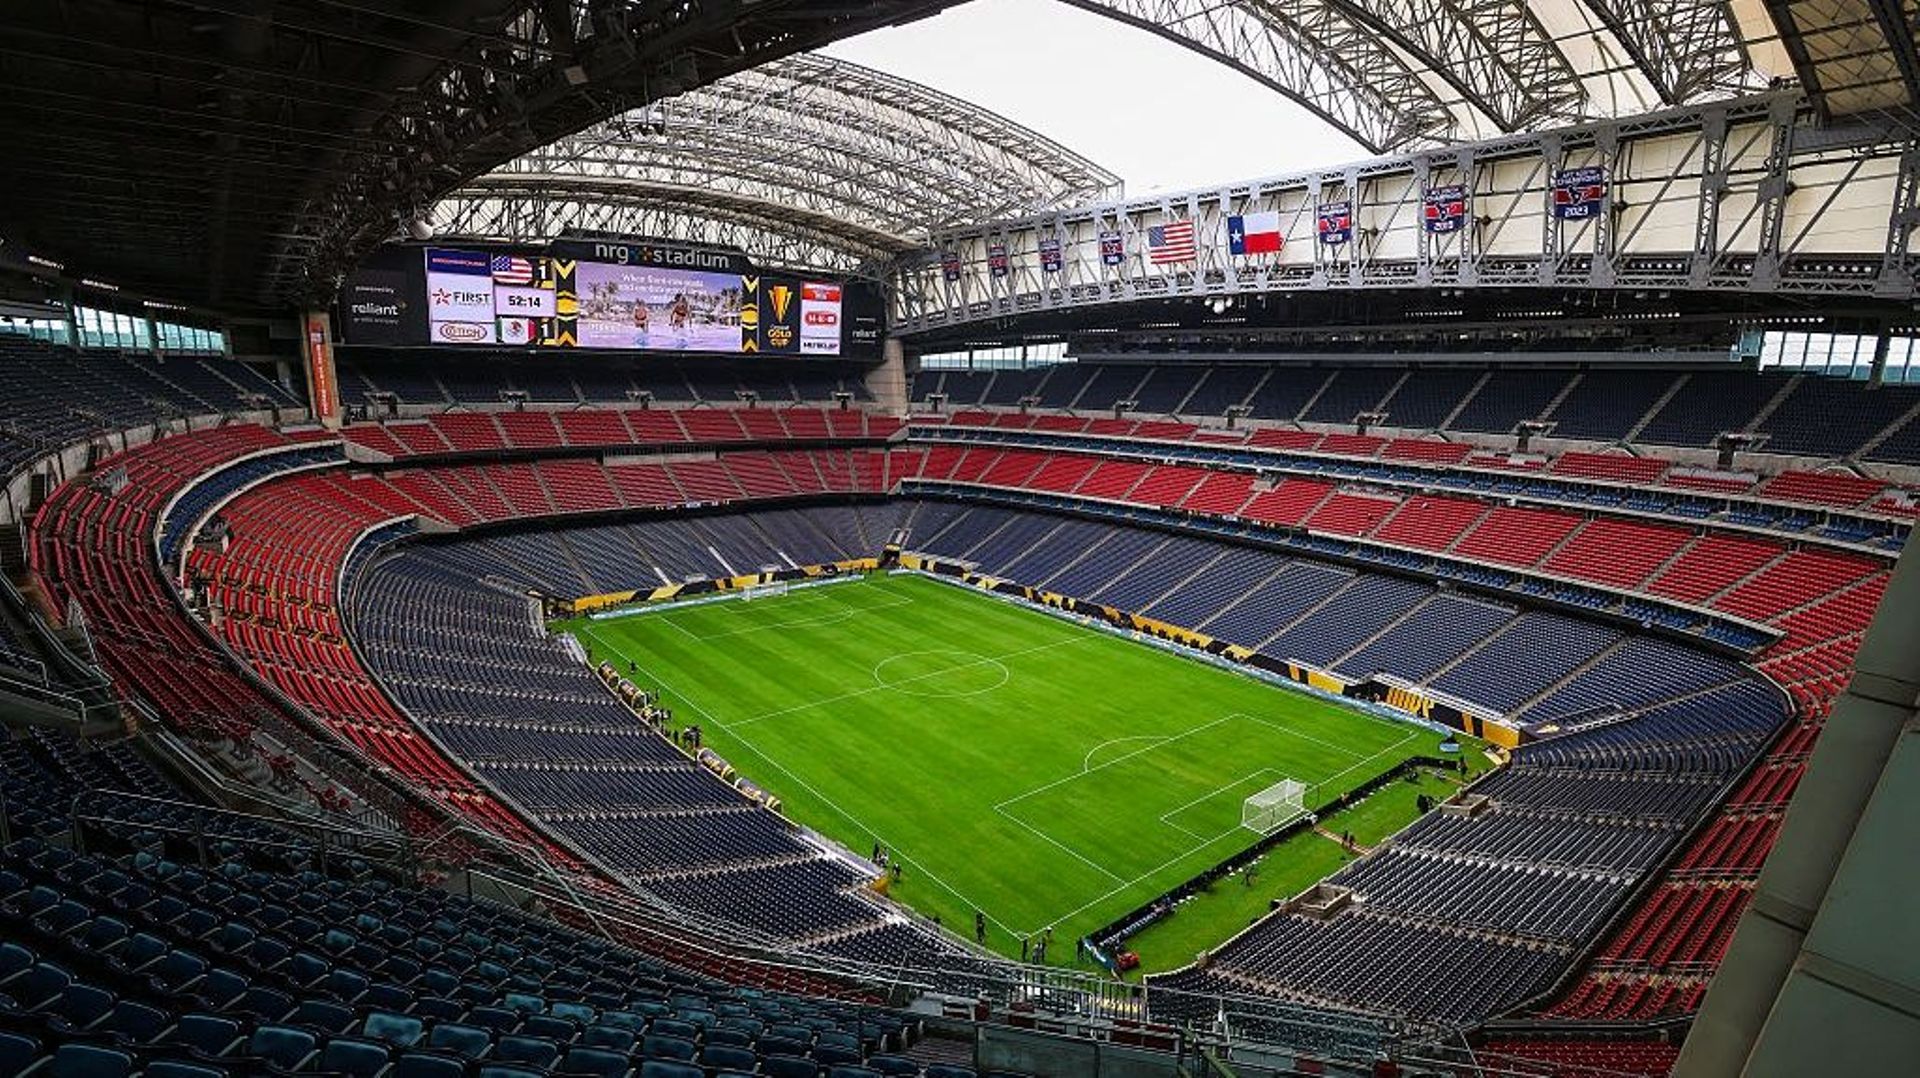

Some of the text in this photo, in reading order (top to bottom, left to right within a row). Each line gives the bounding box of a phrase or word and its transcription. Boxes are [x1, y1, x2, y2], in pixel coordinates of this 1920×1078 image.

[1564, 205, 1589, 218] 2023
[595, 243, 729, 268] nrg stadium
[538, 265, 546, 279] 1
[453, 291, 491, 303] FIRST
[508, 295, 541, 308] 52:14
[351, 302, 399, 315] reliant
[541, 323, 549, 337] 1
[768, 329, 792, 338] GOLD
